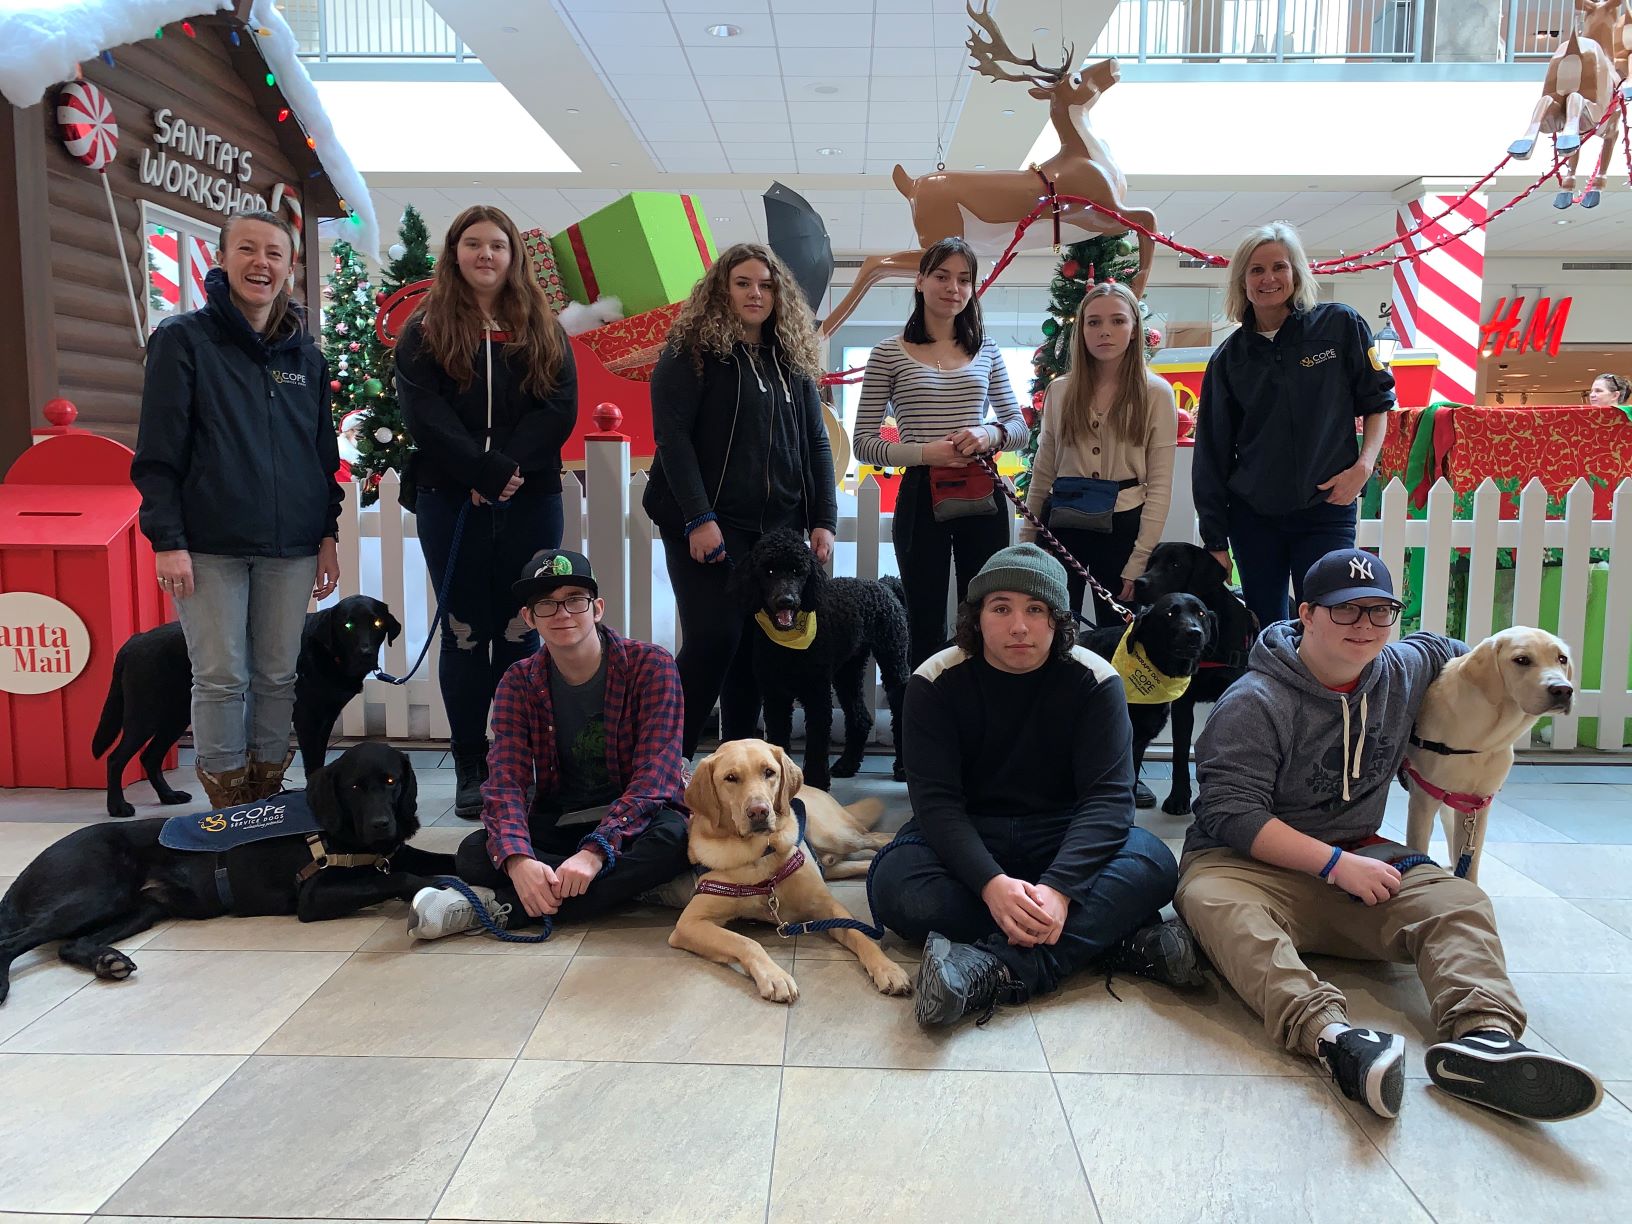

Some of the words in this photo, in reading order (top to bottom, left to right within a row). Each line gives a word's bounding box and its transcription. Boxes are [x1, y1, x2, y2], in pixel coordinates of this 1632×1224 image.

[153, 109, 252, 182] SANTA'S
[1479, 296, 1572, 357] H&M
[1313, 349, 1336, 361] COPE
[282, 372, 306, 383] COPE
[12, 647, 73, 674] Mail
[1135, 669, 1155, 692] COPE
[231, 805, 286, 821] COPE
[231, 819, 260, 828] SERVICE
[264, 814, 284, 822] DOGS
